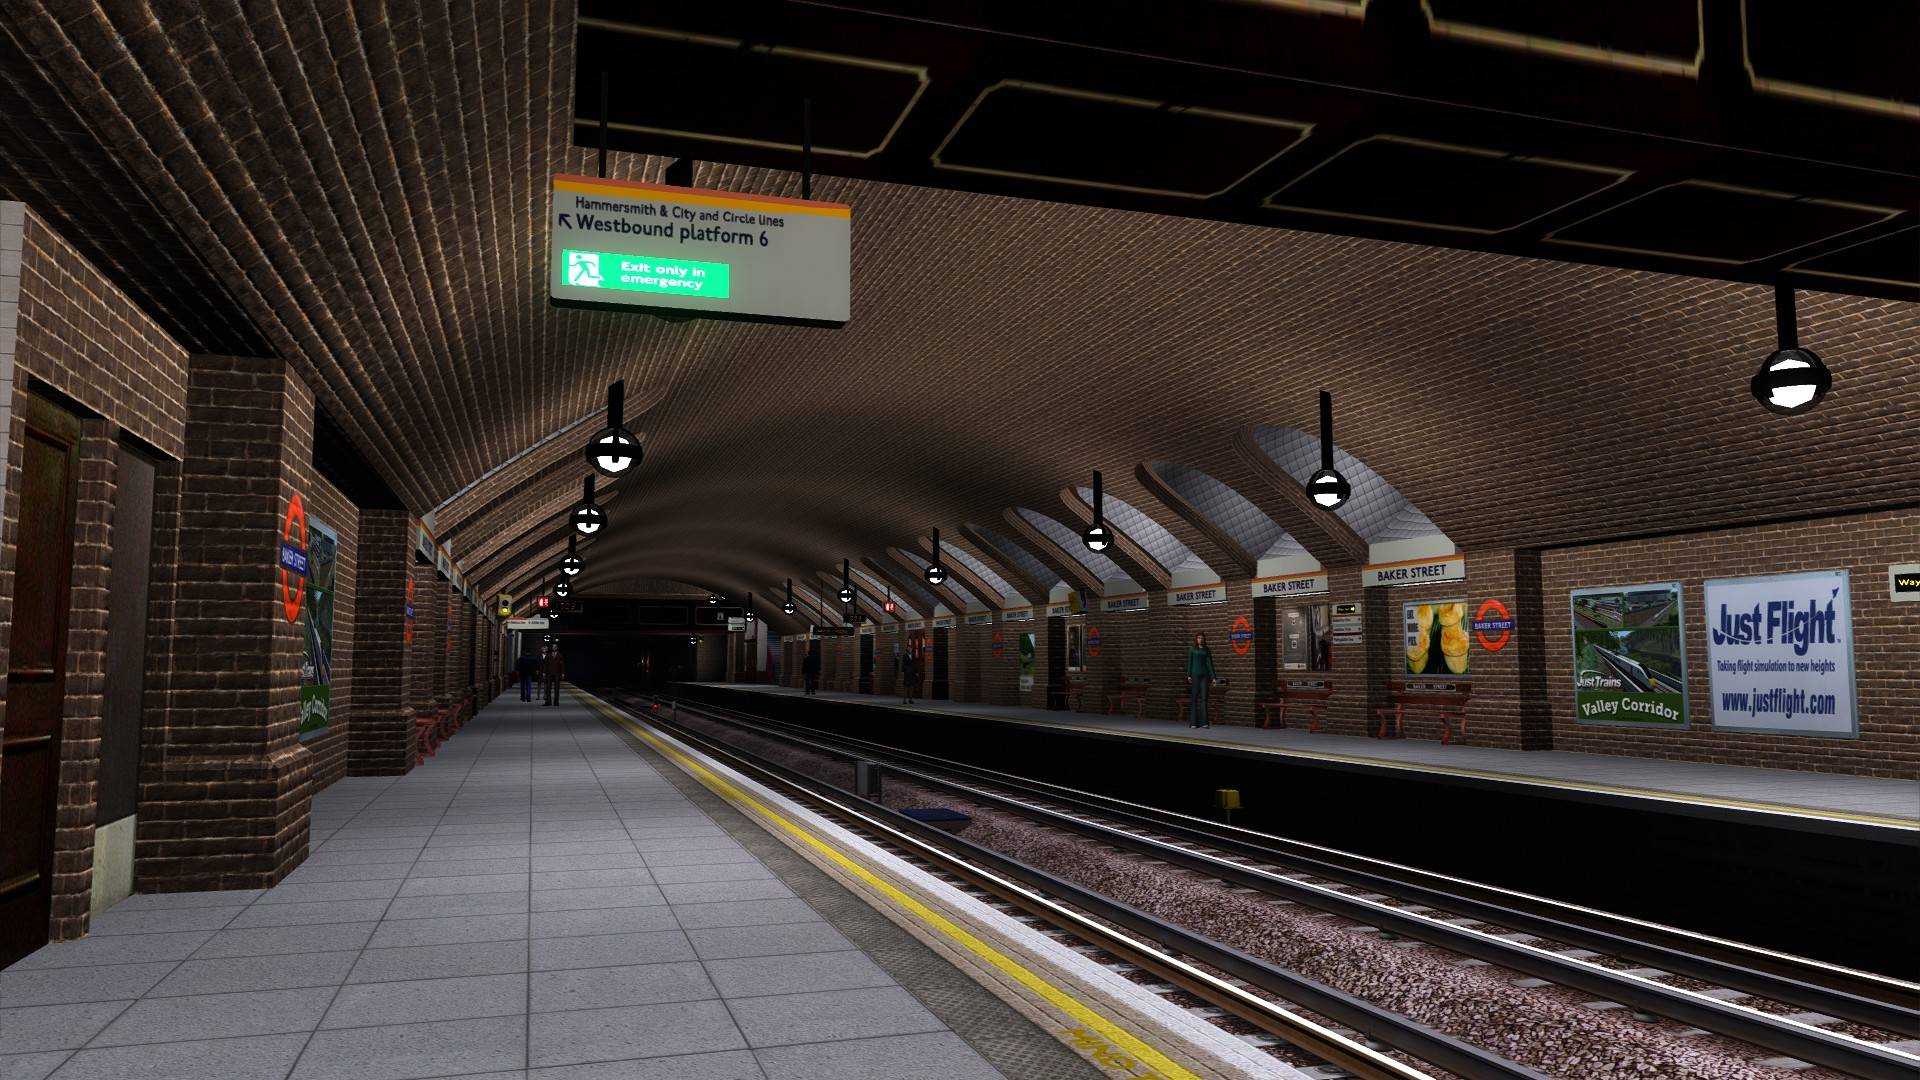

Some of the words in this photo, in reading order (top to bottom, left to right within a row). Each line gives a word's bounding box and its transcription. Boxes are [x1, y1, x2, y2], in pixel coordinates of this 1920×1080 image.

[575, 196, 657, 216] Hammersmith
[660, 204, 668, 217] &
[672, 206, 696, 222] City
[700, 210, 719, 221] and
[723, 211, 755, 224] Circle
[758, 214, 784, 227] lines
[576, 213, 674, 238] Westbound
[680, 223, 753, 244] platform
[759, 230, 769, 247] 6
[621, 261, 651, 273] Exit
[655, 265, 688, 278] only
[692, 267, 706, 278] in
[621, 274, 703, 291] emergency
[1377, 569, 1408, 581] BAKER
[1411, 564, 1446, 578] STREET
[1263, 582, 1287, 593] BAKER
[1288, 579, 1315, 591] STREET
[1898, 578, 1920, 587] Way
[1176, 592, 1195, 602] BAKER
[1195, 589, 1217, 600] STREET
[1474, 621, 1491, 630] BAKER
[1491, 620, 1512, 629] STREET
[1713, 602, 1762, 645] Just
[1766, 599, 1836, 656] Flight
[1717, 660, 1736, 674] Taking
[1737, 660, 1753, 675] flight
[1754, 660, 1787, 673] simulation
[1788, 661, 1796, 673] to
[1796, 663, 1809, 673] new
[1810, 660, 1836, 675] heights
[1582, 700, 1618, 716] Valley
[1621, 697, 1680, 721] Corridor
[1722, 688, 1836, 719] www.justflight.com
